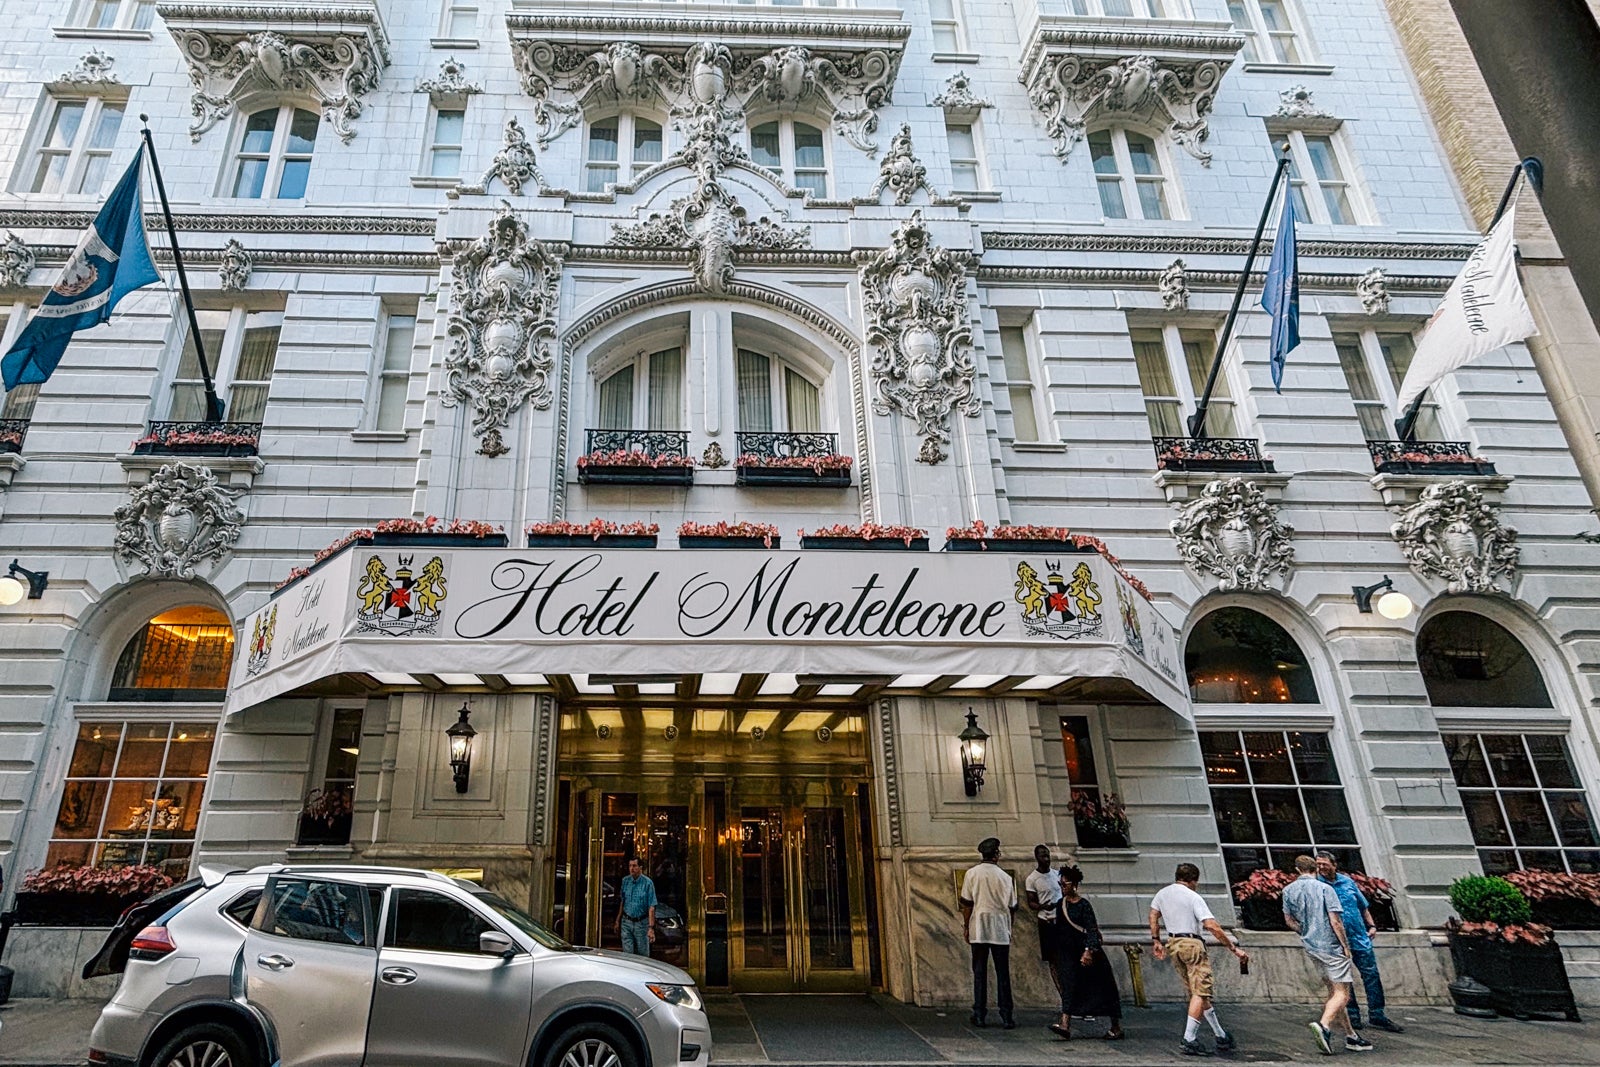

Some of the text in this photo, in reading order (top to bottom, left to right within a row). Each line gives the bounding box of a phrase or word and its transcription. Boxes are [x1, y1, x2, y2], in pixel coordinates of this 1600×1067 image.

[1460, 263, 1495, 336] Monteleone
[295, 577, 326, 618] Hotel
[455, 553, 1006, 638] Hotel Monteleone
[281, 617, 330, 661] Monteleone
